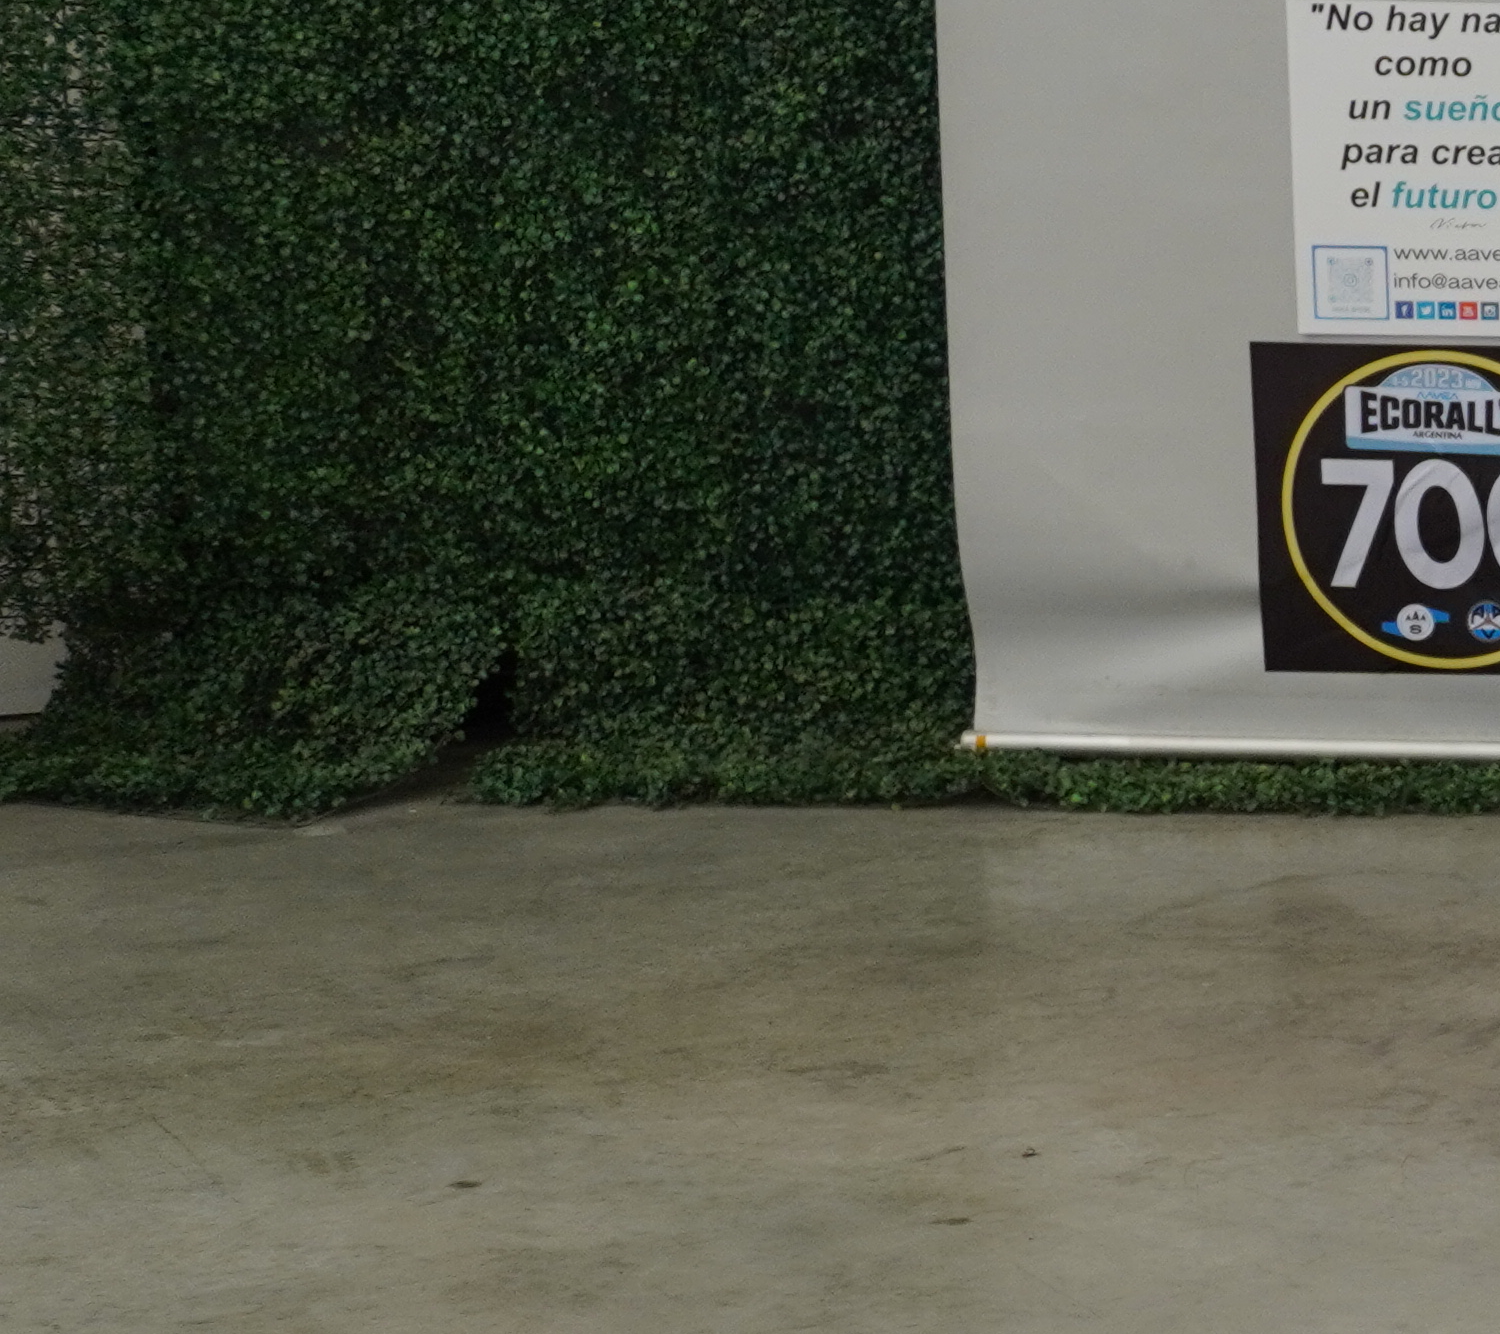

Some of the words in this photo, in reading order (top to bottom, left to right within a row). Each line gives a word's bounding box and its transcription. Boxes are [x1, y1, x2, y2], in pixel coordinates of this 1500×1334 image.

[1311, 3, 1373, 31] "No
[1386, 5, 1450, 39] hay
[1374, 55, 1472, 77] como
[1348, 98, 1391, 120] un
[1341, 142, 1419, 170] para
[1350, 181, 1380, 208] el
[1410, 368, 1463, 389] 2023
[1412, 430, 1463, 440] ARGENTINA
